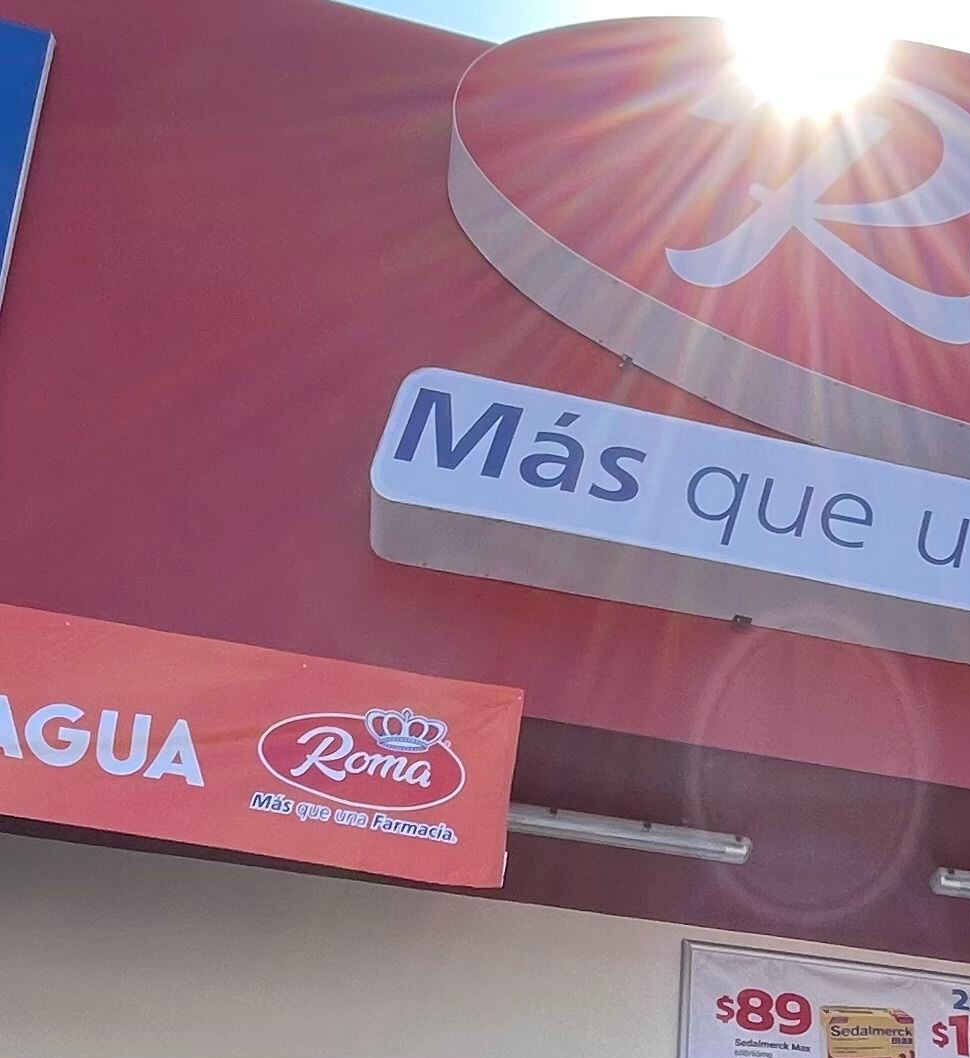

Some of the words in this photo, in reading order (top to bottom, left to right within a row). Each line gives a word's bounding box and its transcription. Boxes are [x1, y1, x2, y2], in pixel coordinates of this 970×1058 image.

[394, 388, 647, 503] Más
[686, 465, 874, 549] que
[290, 725, 432, 789] Roma
[251, 792, 292, 815] Más
[297, 801, 332, 823] que
[334, 809, 370, 828] una
[715, 987, 813, 1036] $89
[830, 1025, 913, 1037] Sedalmerck
[734, 1038, 790, 1051] Sedalmerck
